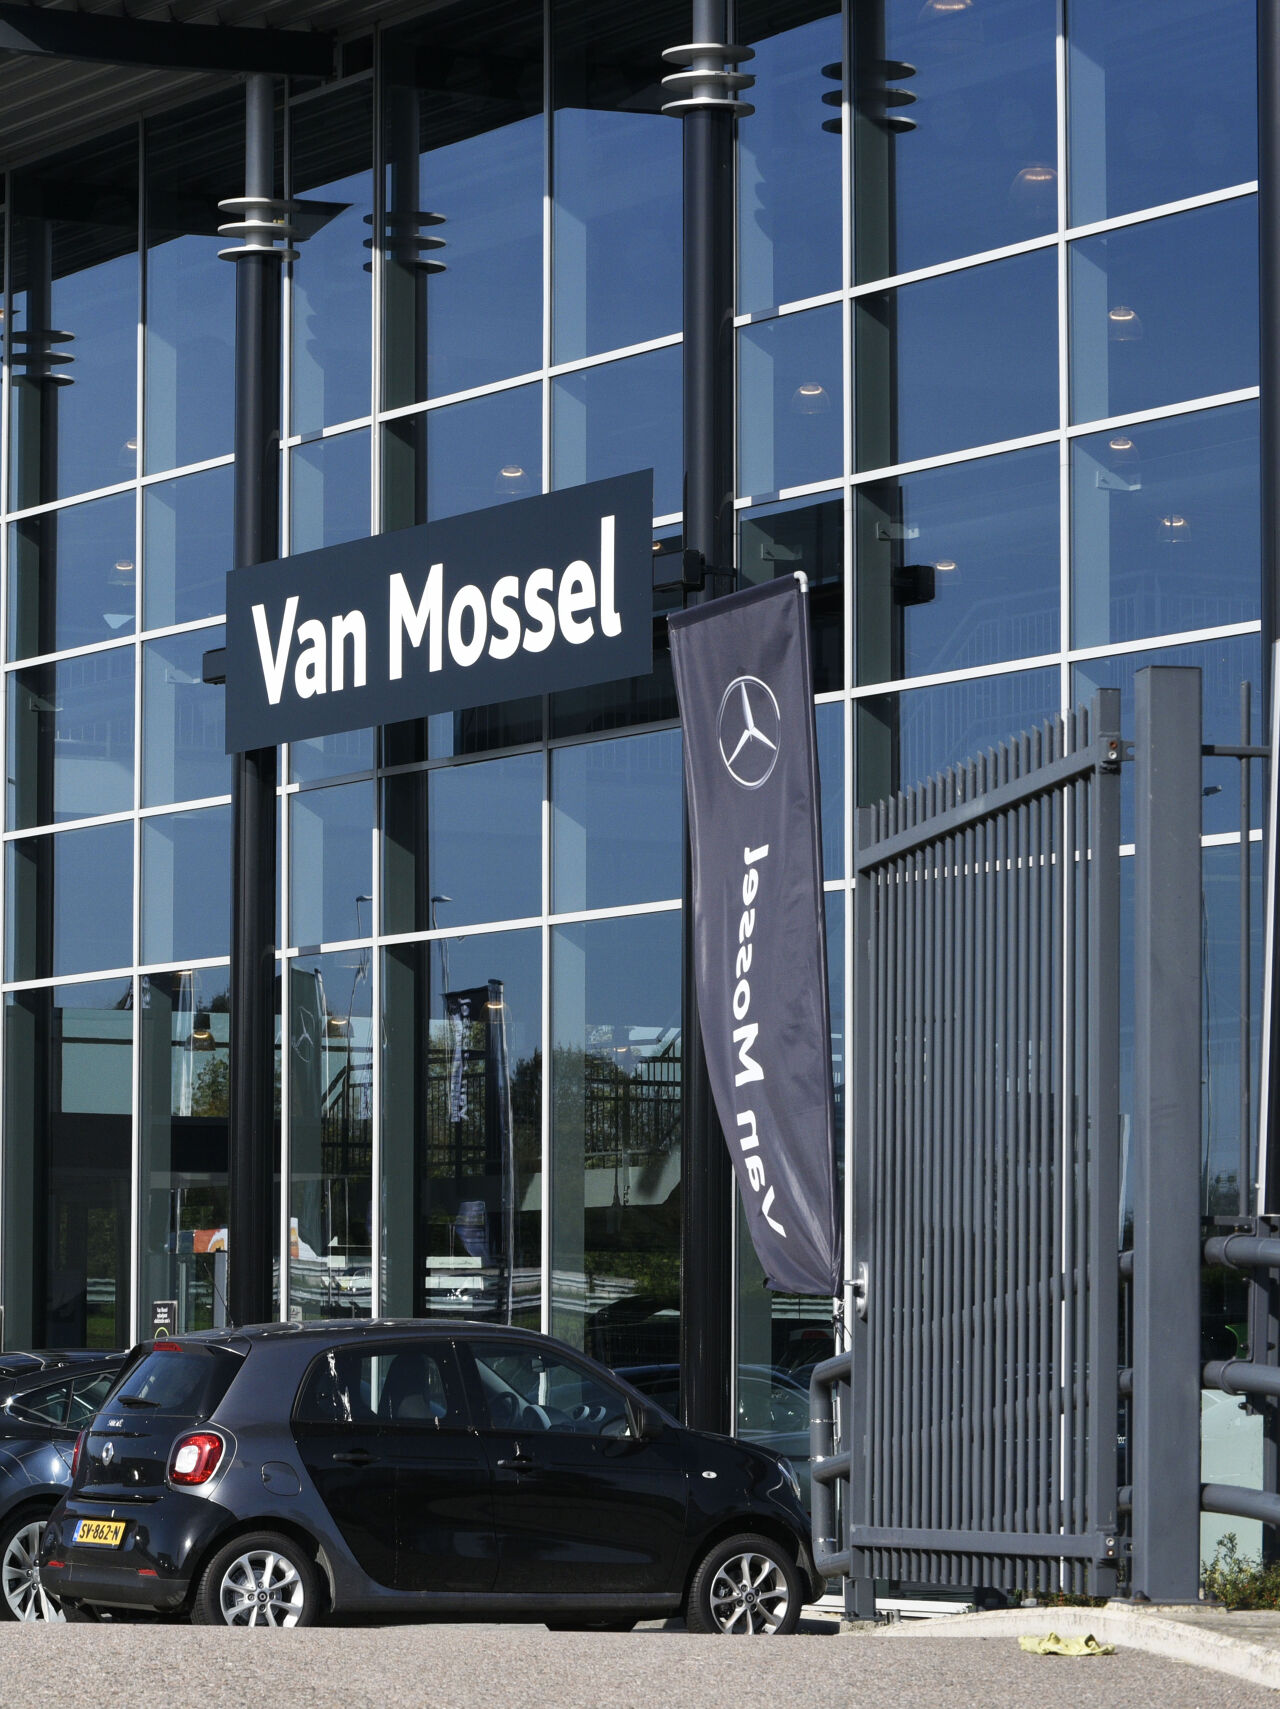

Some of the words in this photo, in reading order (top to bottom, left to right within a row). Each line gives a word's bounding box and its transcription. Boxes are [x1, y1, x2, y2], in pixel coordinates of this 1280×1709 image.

[252, 596, 367, 705] Van
[389, 515, 622, 680] Mossel
[79, 1523, 122, 1541] SV-862-N
